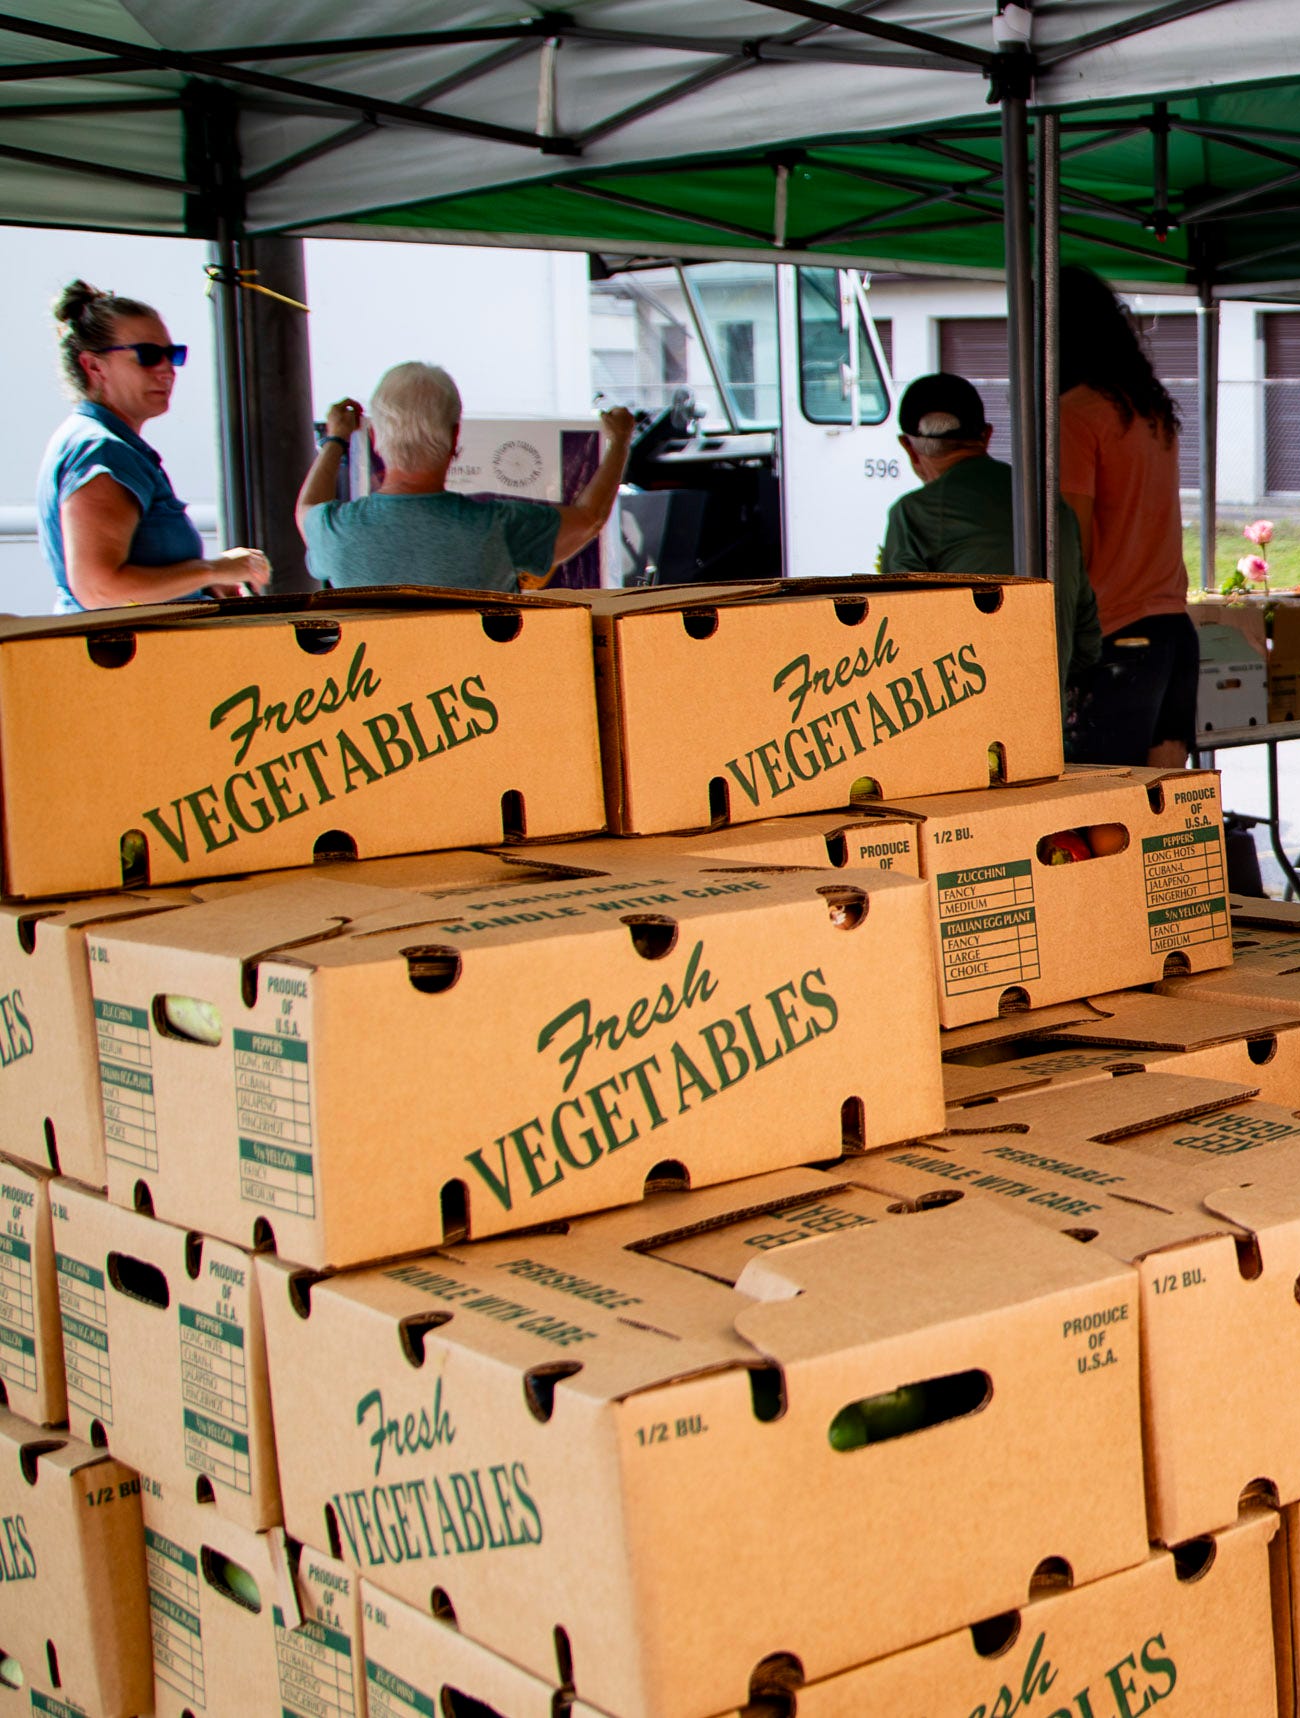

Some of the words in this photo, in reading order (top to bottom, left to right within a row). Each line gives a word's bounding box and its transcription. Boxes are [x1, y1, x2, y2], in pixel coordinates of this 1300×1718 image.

[864, 458, 899, 478] 596
[773, 616, 899, 723] Fresh
[210, 642, 381, 767] Fresh
[725, 643, 987, 808] VEGETABLES
[143, 675, 499, 864] VEGETABLES
[1174, 787, 1216, 804] PRODUCE
[1190, 802, 1203, 815] OF
[1185, 815, 1211, 829] U.S.A.
[933, 830, 953, 845] 1/2
[955, 827, 974, 841] BU.
[1162, 832, 1194, 848] PEPPERS
[860, 839, 911, 860] PRODUCE
[1147, 849, 1172, 864] LONG
[1173, 845, 1196, 859] HOTS
[957, 866, 1006, 884] ZUCCHINI
[1149, 874, 1190, 893] JALAPENO
[467, 878, 677, 911] PERISHABLE
[944, 886, 977, 901] FANCY
[1151, 886, 1198, 905] FINGERHOT
[441, 904, 586, 934] HANDLE
[589, 893, 679, 913] WITH
[682, 879, 771, 899] CARE
[945, 898, 987, 915] MEDIUM
[1178, 902, 1211, 919] YELLOW
[947, 919, 983, 936] ITALIAN
[983, 914, 1003, 930] EGG
[1003, 911, 1031, 925] PLANT
[1153, 923, 1181, 937] FANCY
[948, 935, 981, 950] FANCY
[1153, 934, 1191, 950] MEDIUM
[949, 949, 981, 965] LARGE
[950, 962, 989, 978] CHOICE
[268, 976, 308, 998] PRODUCE
[281, 998, 293, 1015] OF
[537, 940, 719, 1092] Fresh
[275, 1018, 301, 1037] U.S.A.
[252, 1036, 283, 1055] PEPPERS
[464, 967, 840, 1212] VEGETABLES
[982, 1146, 1127, 1187] PERISHABLE
[886, 1152, 981, 1189] HANDLE
[967, 1173, 1033, 1202] WITH
[1023, 1189, 1104, 1218] CARE
[1, 1184, 34, 1207] PRODUCE
[12, 1205, 23, 1221] OF
[209, 1260, 245, 1287] PRODUCE
[1151, 1273, 1179, 1295] 1/2
[1181, 1268, 1206, 1288] BU.
[221, 1284, 232, 1301] OF
[496, 1258, 644, 1311] PERISHABLE
[382, 1264, 471, 1304] HANDLE
[461, 1297, 524, 1325] WITH
[517, 1313, 598, 1347] CARE
[1062, 1303, 1129, 1339] PRODUCE
[1087, 1331, 1106, 1349] OF
[1077, 1349, 1118, 1375] U.S.A.
[356, 1375, 456, 1476] Fresh
[636, 1422, 669, 1448] 1/2
[675, 1415, 709, 1439] BU.
[87, 1487, 114, 1507] 1/2
[333, 1461, 544, 1569] VEGETABLES
[308, 1563, 350, 1597] PRODUCE
[323, 1590, 334, 1606] OF
